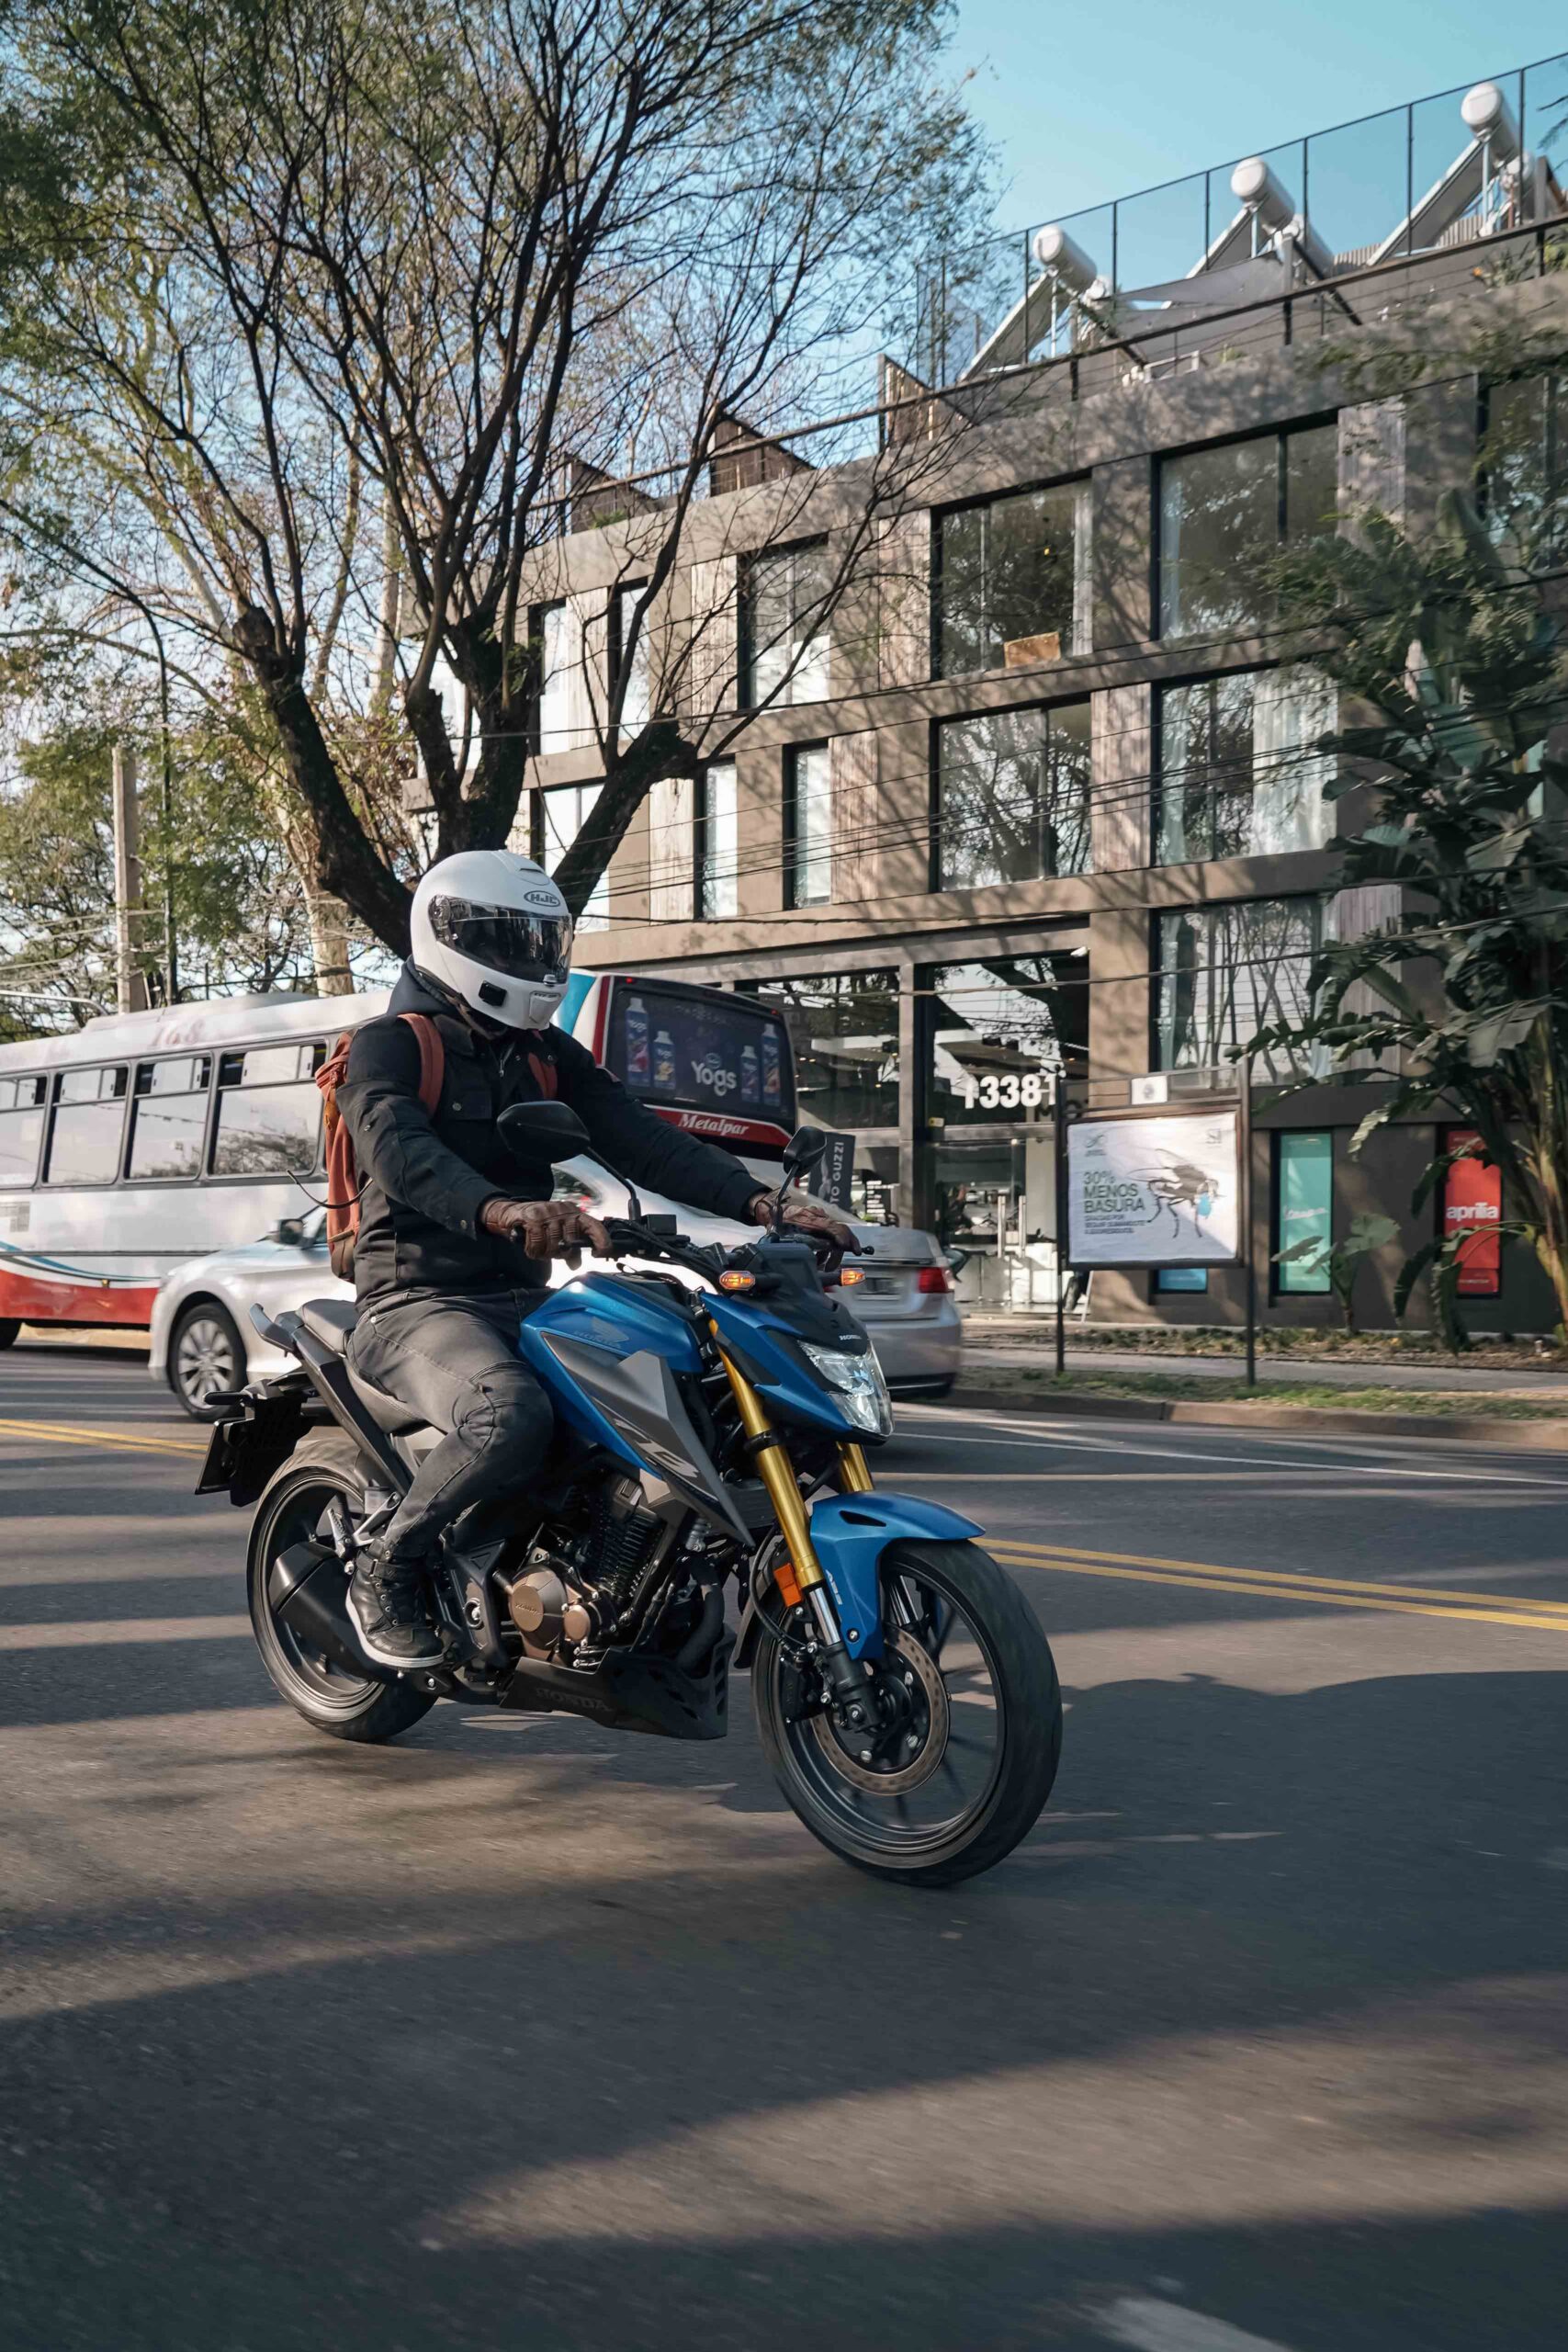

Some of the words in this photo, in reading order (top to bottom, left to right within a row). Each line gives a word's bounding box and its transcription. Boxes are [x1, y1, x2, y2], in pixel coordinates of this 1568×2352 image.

[530, 893, 558, 905] HJC
[691, 1059, 737, 1097] Yogs
[964, 1073, 1056, 1109] 13381
[678, 1113, 750, 1136] Metalpar
[832, 1142, 844, 1182] GUZZI
[1084, 1183, 1139, 1199] MENOS
[1084, 1197, 1146, 1214] BASURA
